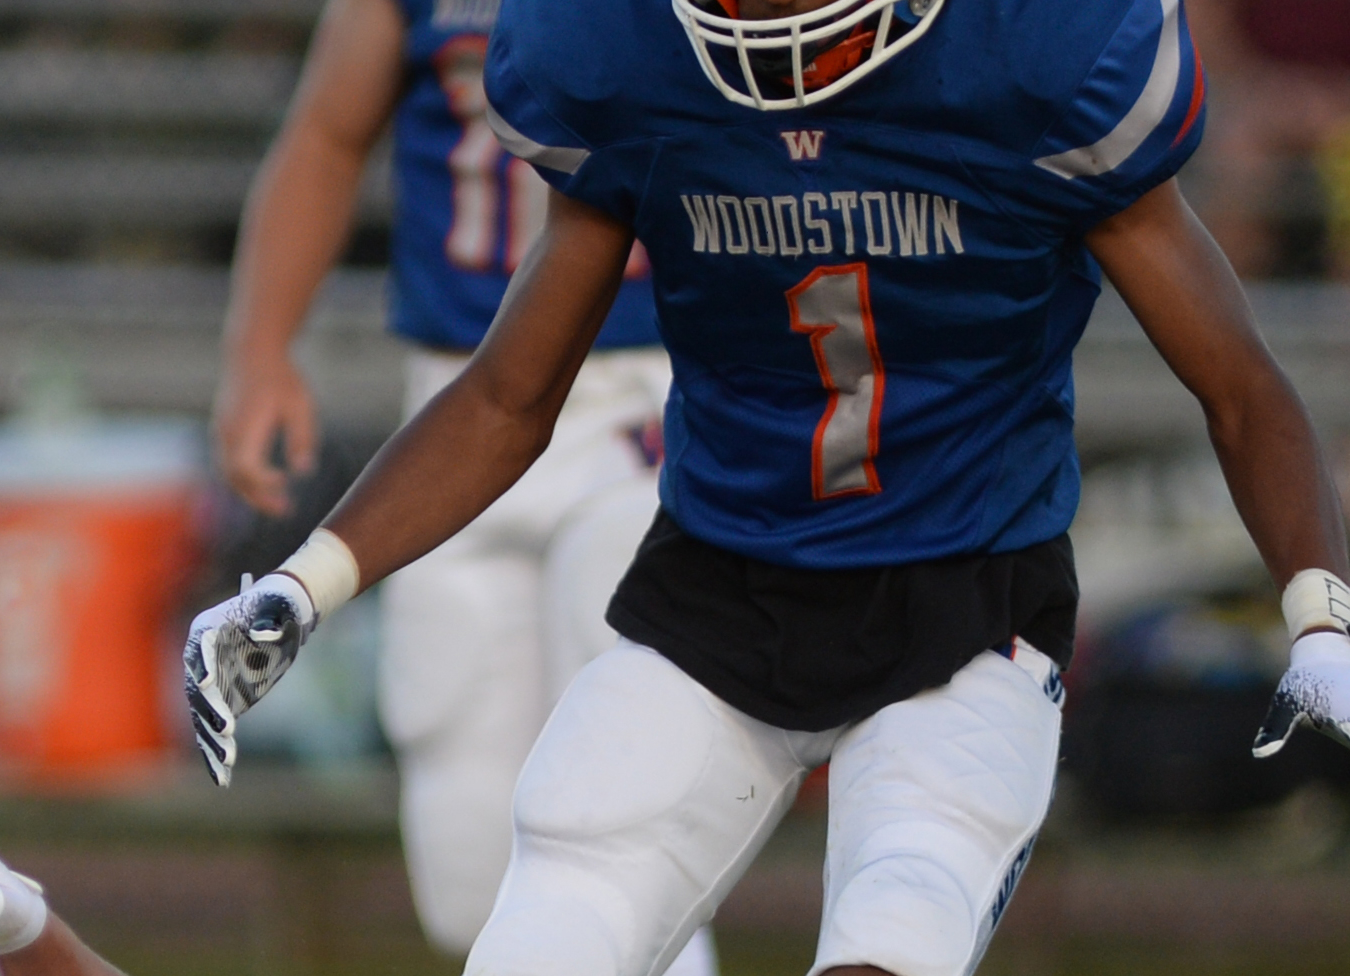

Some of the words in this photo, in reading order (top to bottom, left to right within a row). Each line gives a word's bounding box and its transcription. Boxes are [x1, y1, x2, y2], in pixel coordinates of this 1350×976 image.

[779, 130, 826, 161] W
[682, 192, 966, 258] WOODSTOWN
[786, 262, 885, 501] 1
